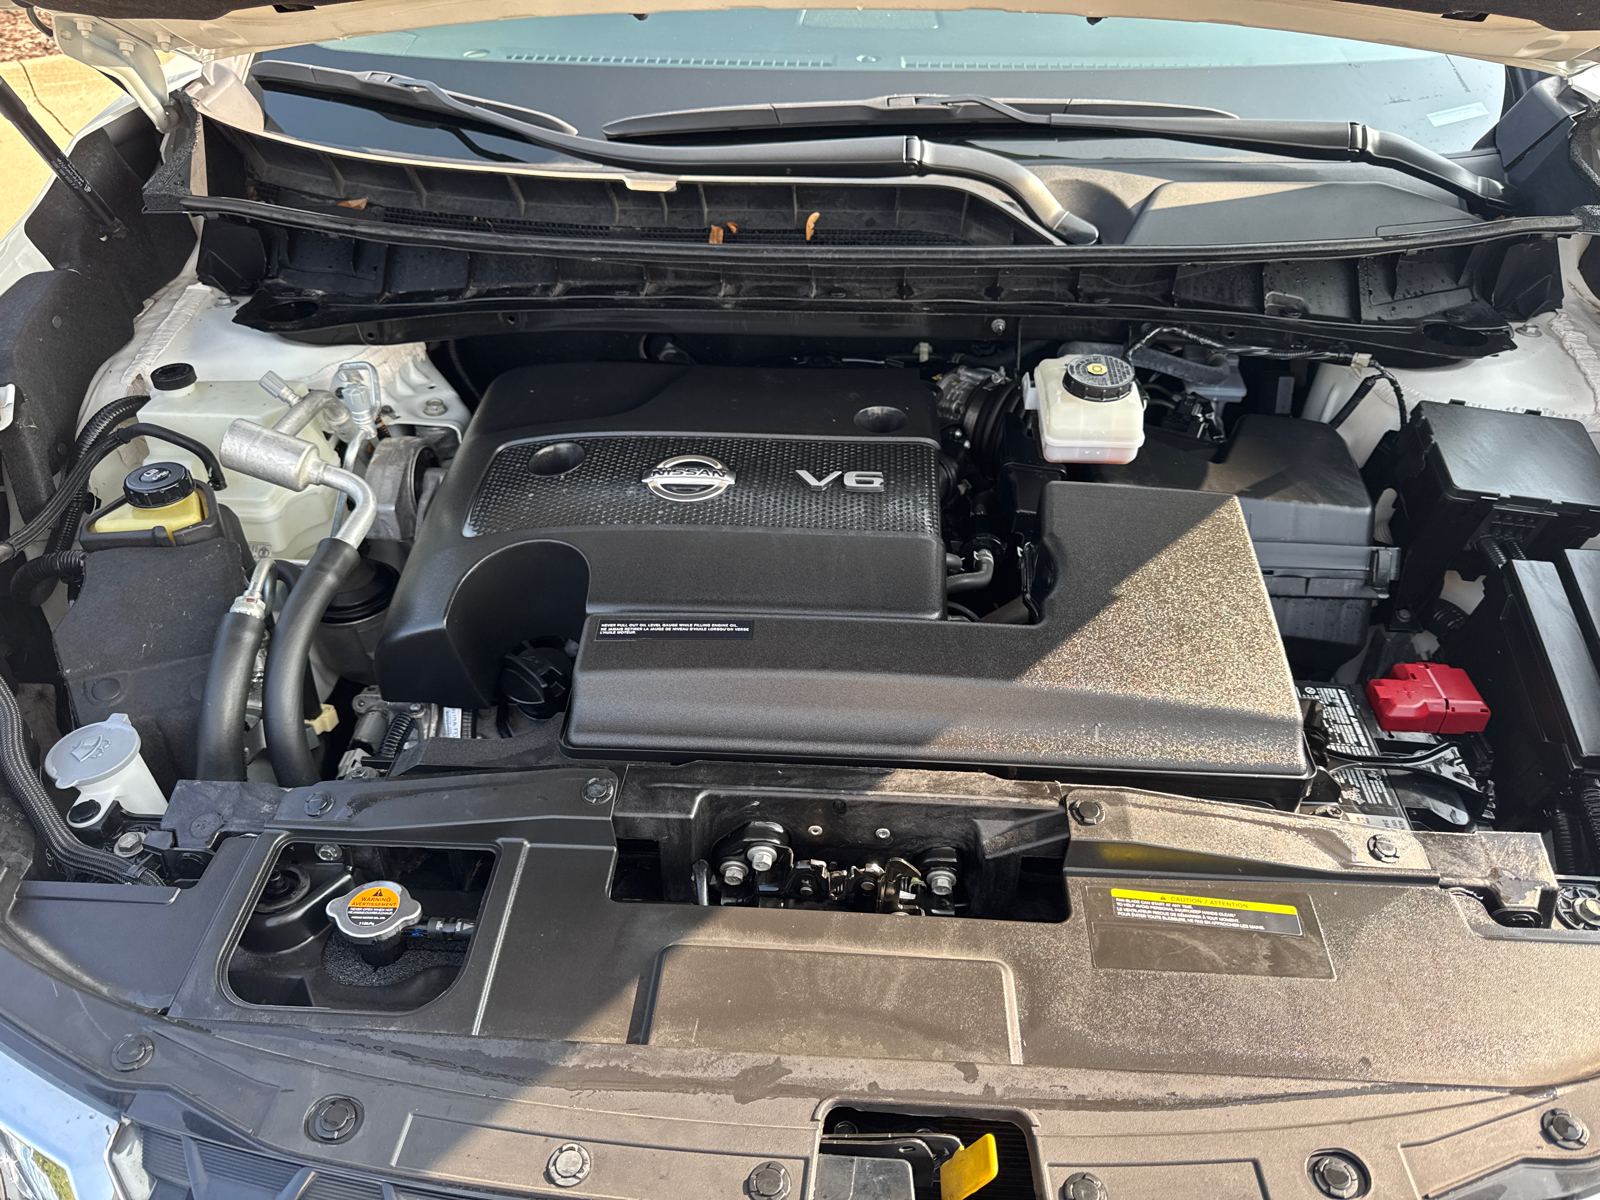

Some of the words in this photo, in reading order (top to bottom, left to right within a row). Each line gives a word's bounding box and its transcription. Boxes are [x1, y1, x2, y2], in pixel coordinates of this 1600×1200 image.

[652, 467, 727, 478] NISSAN
[795, 469, 884, 492] V6
[1171, 896, 1202, 904] CAUTION
[1210, 900, 1248, 908] ATTENTION
